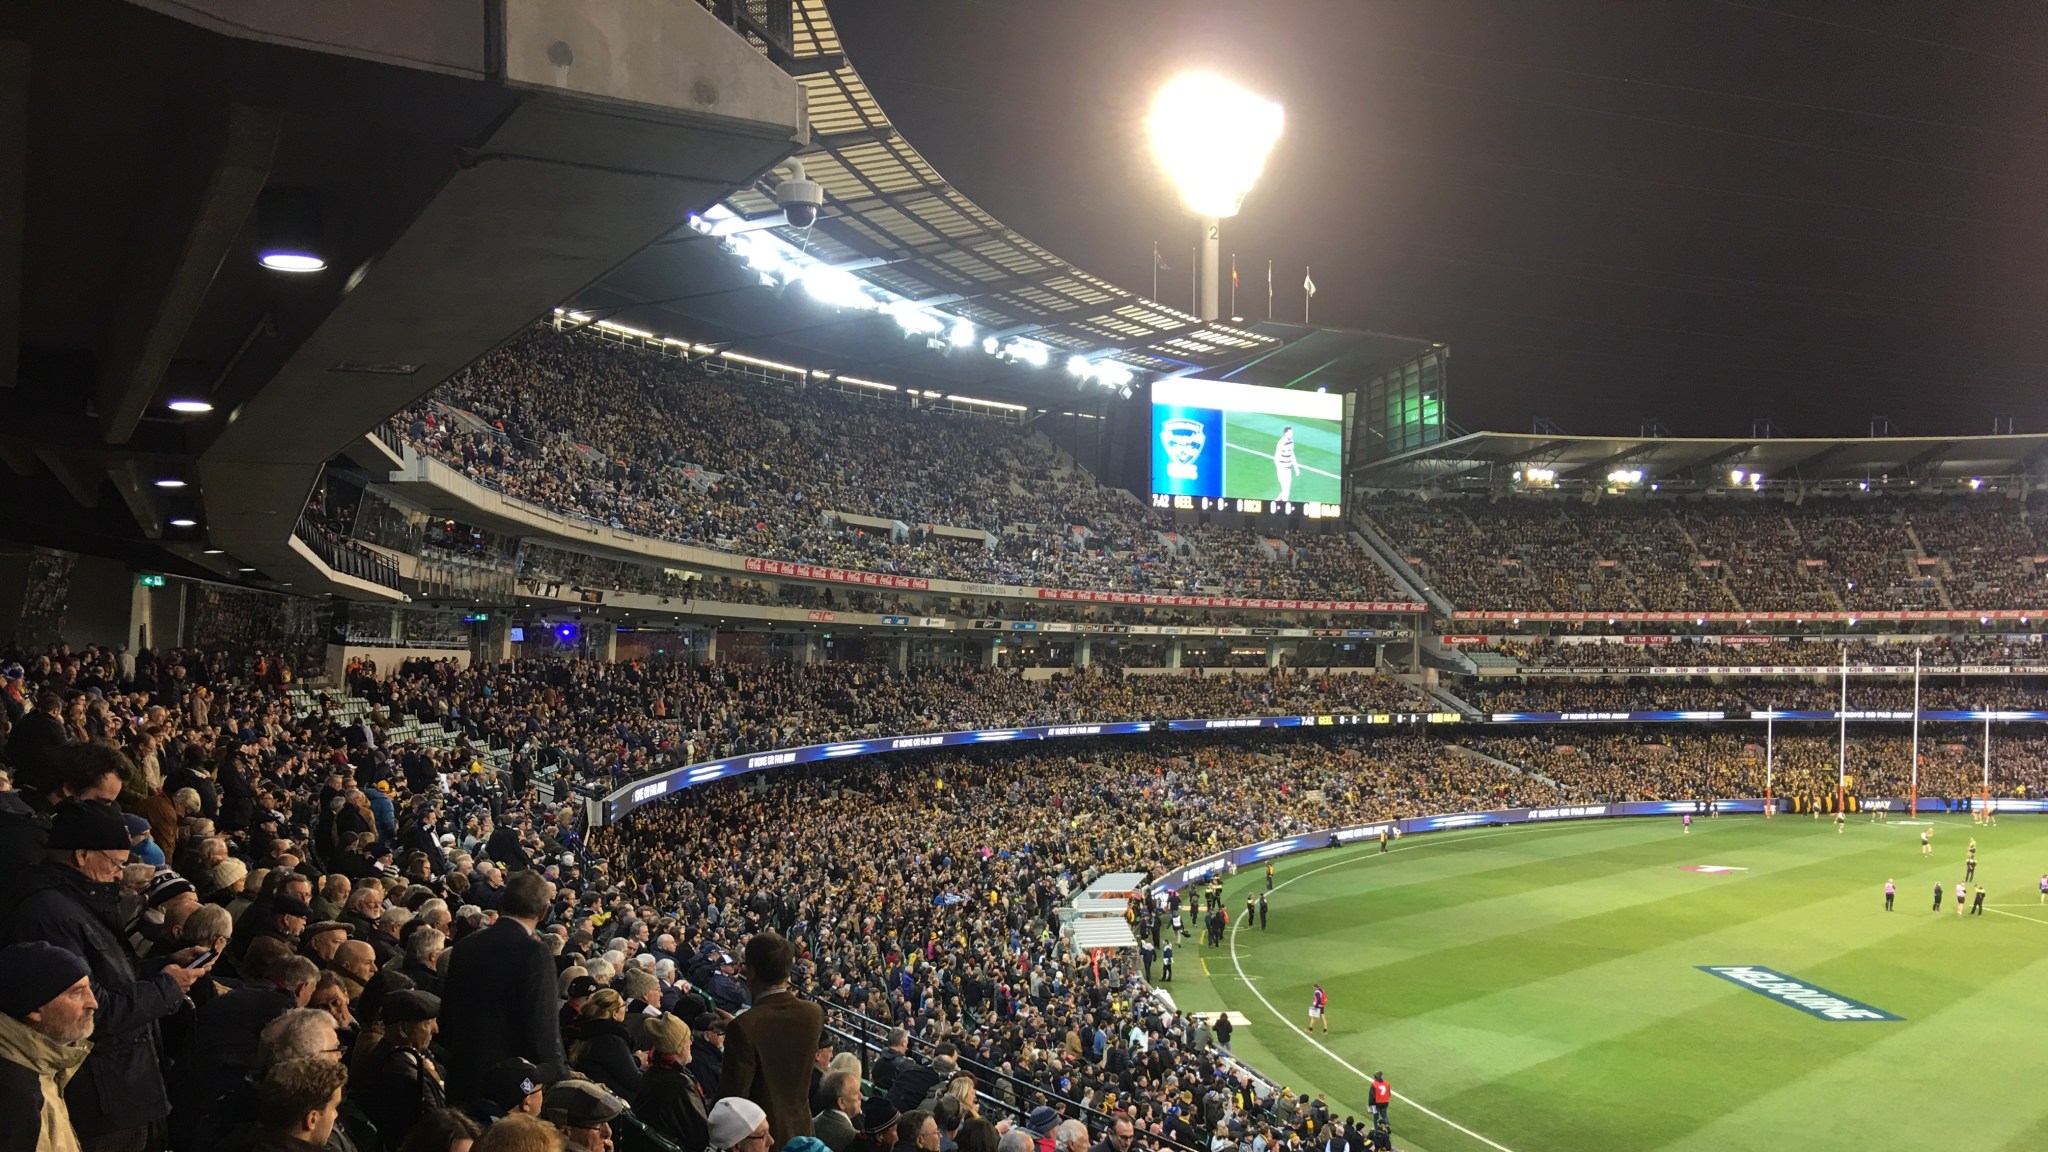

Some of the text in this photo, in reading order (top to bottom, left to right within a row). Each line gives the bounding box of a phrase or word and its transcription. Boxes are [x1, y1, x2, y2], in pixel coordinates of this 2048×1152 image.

[1210, 226, 1218, 240] 2
[1318, 716, 1333, 725] GEEL
[1374, 715, 1389, 723] RICH
[1538, 809, 1558, 817] HOME
[1710, 966, 1884, 1019] MELBOURNE
[1378, 1086, 1386, 1096] 7
